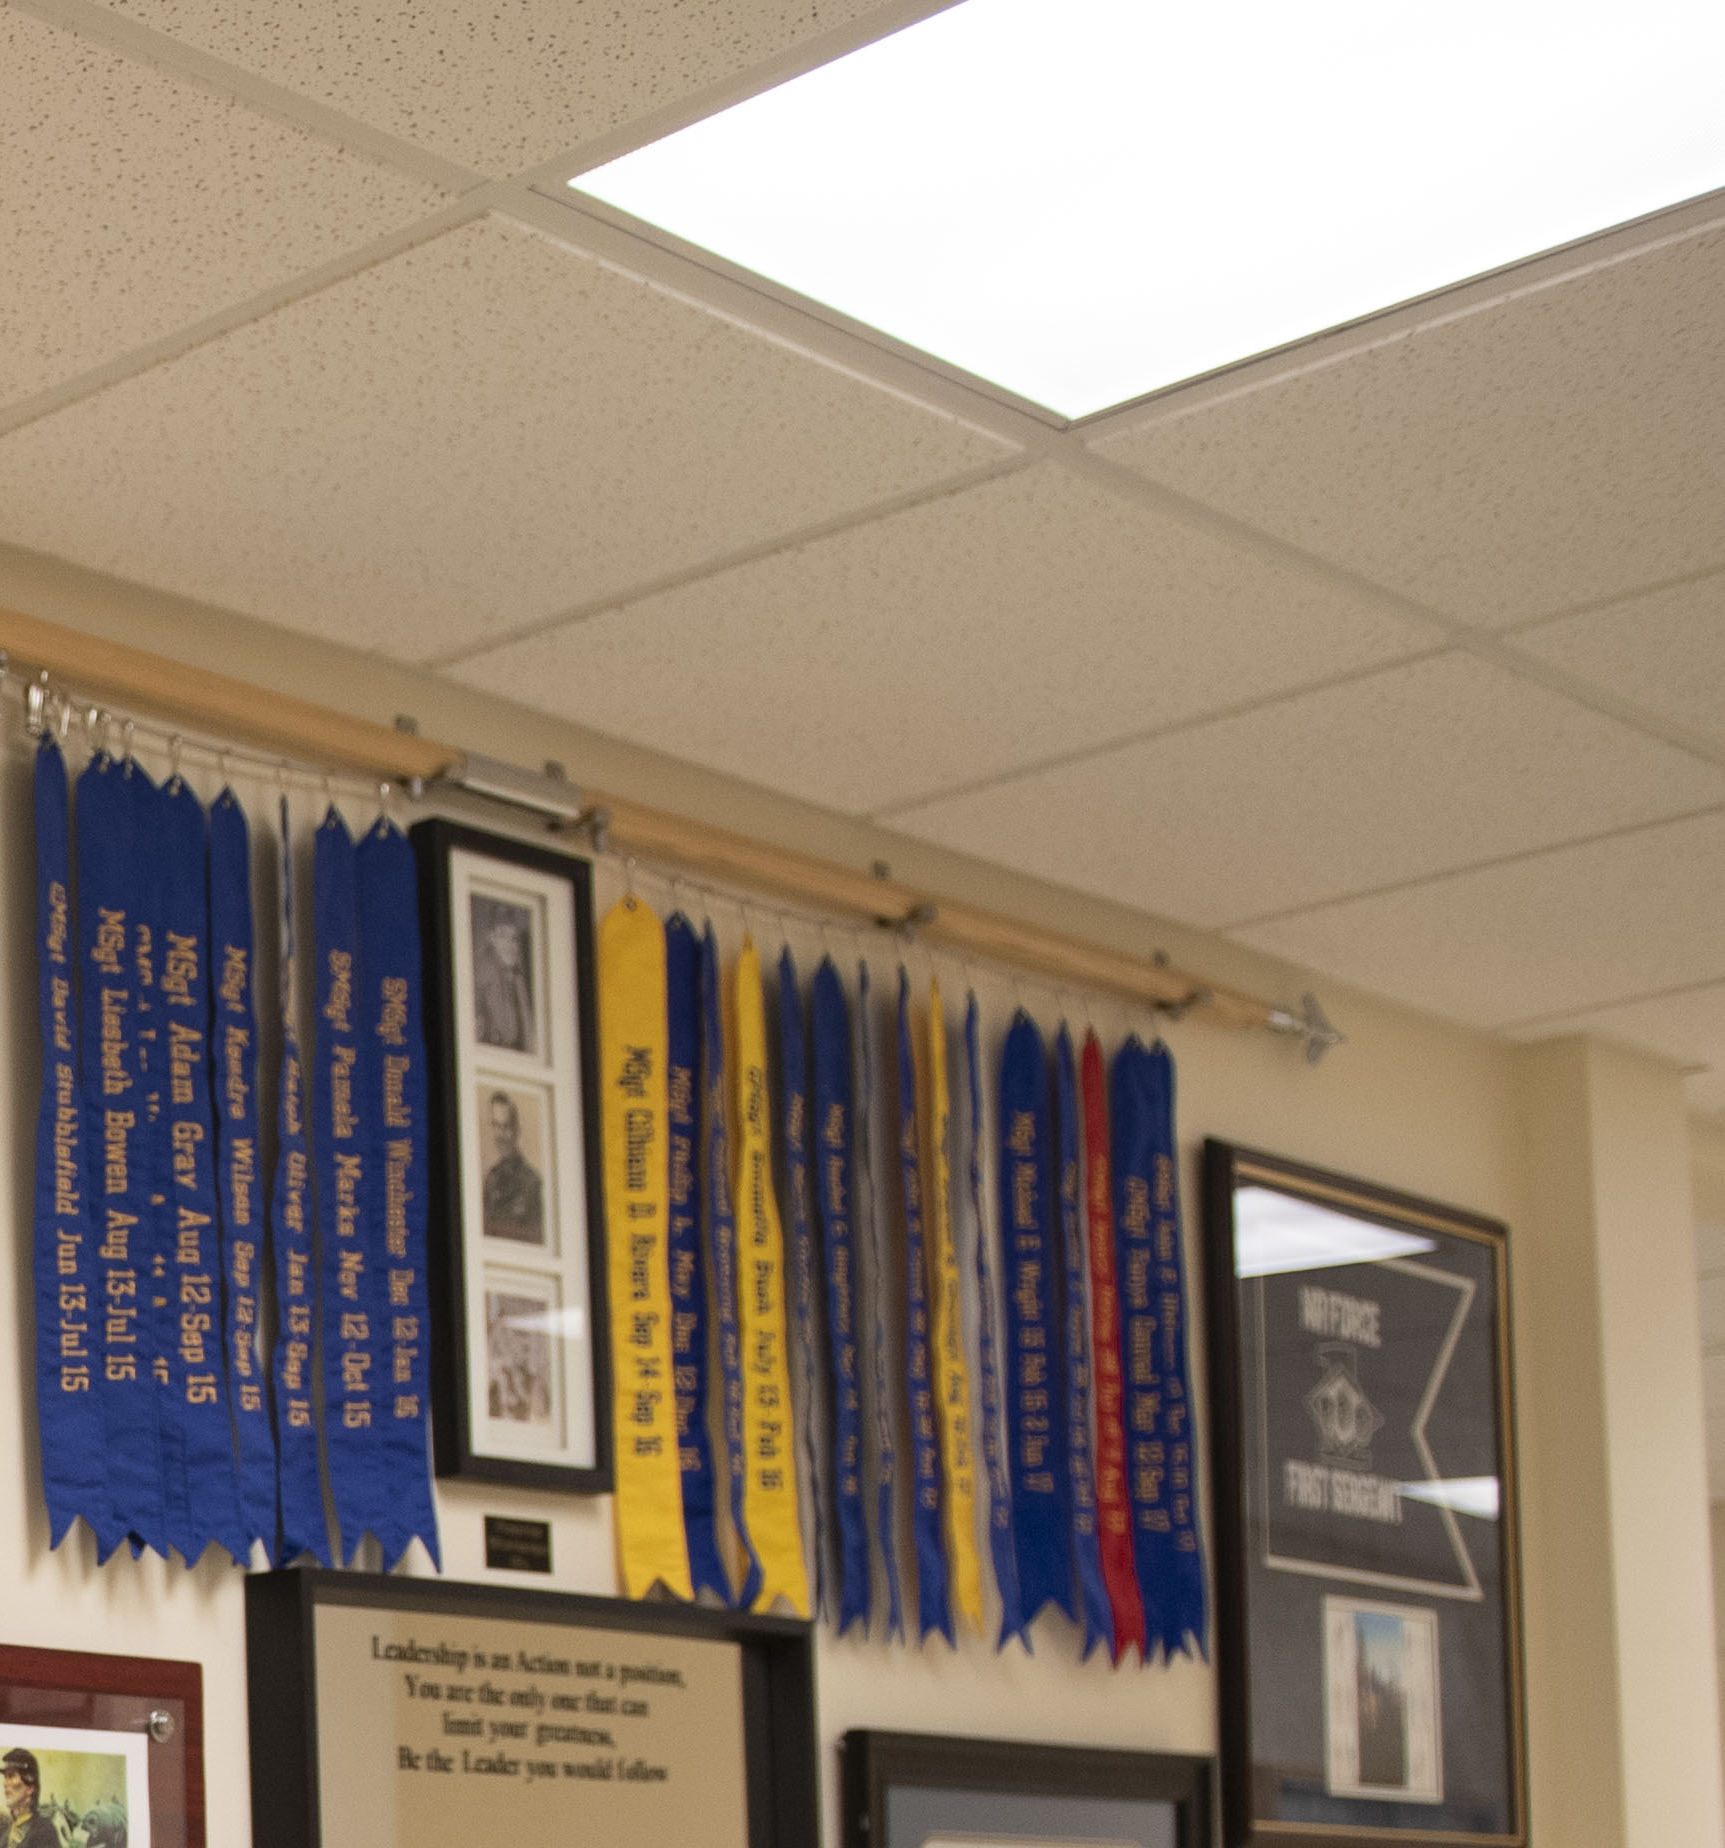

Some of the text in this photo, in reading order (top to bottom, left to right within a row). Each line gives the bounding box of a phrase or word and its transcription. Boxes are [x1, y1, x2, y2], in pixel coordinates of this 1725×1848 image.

[90, 906, 127, 974] MSgt
[51, 975, 72, 1052] David
[103, 1109, 135, 1195] Bowen
[161, 931, 217, 1404] MSgt Adam Gray Aug 12-Sep 15
[57, 1227, 84, 1275] Jun
[98, 1208, 138, 1260] Aug
[59, 1282, 87, 1358] 13-Jul
[104, 1268, 136, 1345] 13-Jul
[60, 1362, 89, 1393] 15
[105, 1353, 136, 1382] 15
[372, 1636, 468, 1673] Leadership
[475, 1650, 487, 1670] is
[492, 1654, 512, 1671] an
[515, 1651, 569, 1677] Action
[575, 1659, 601, 1678] not
[606, 1662, 613, 1678] a
[405, 1674, 649, 1718] You are the only one that can
[443, 1712, 483, 1738] limit
[488, 1718, 528, 1743] your
[398, 1746, 668, 1783] Be the Leader you would follow
